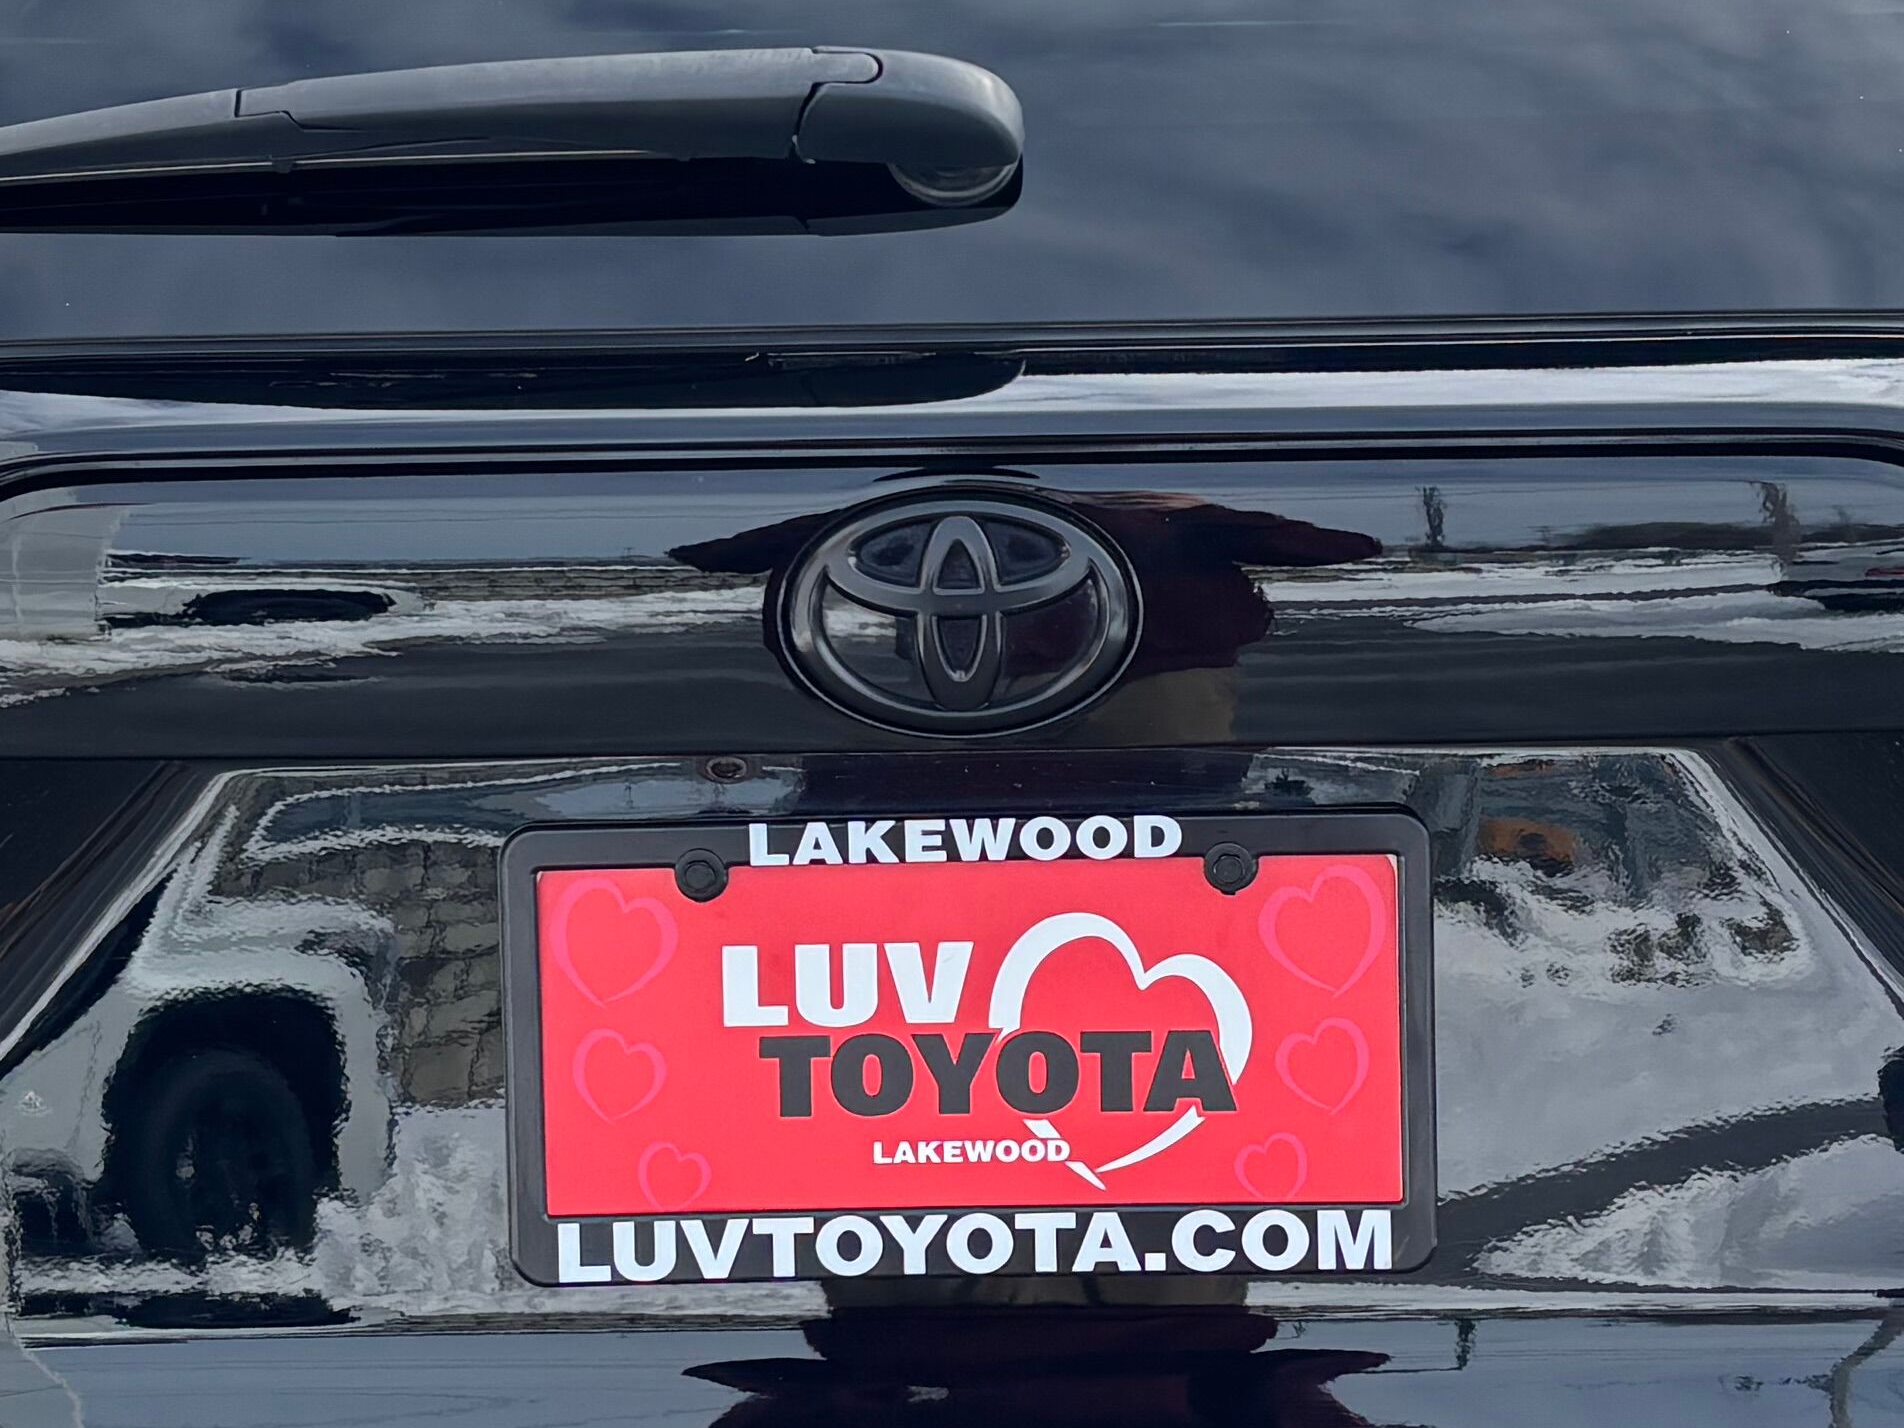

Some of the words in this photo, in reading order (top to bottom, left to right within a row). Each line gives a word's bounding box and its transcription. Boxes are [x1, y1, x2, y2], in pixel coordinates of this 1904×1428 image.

[749, 815, 1183, 867] LAKEWOOD
[722, 941, 974, 1028] LUV
[758, 1030, 1236, 1117] TOYOTA
[873, 1139, 1071, 1165] LAKEWOOD
[557, 1209, 1392, 1284] LUVTOYOTA.COM
